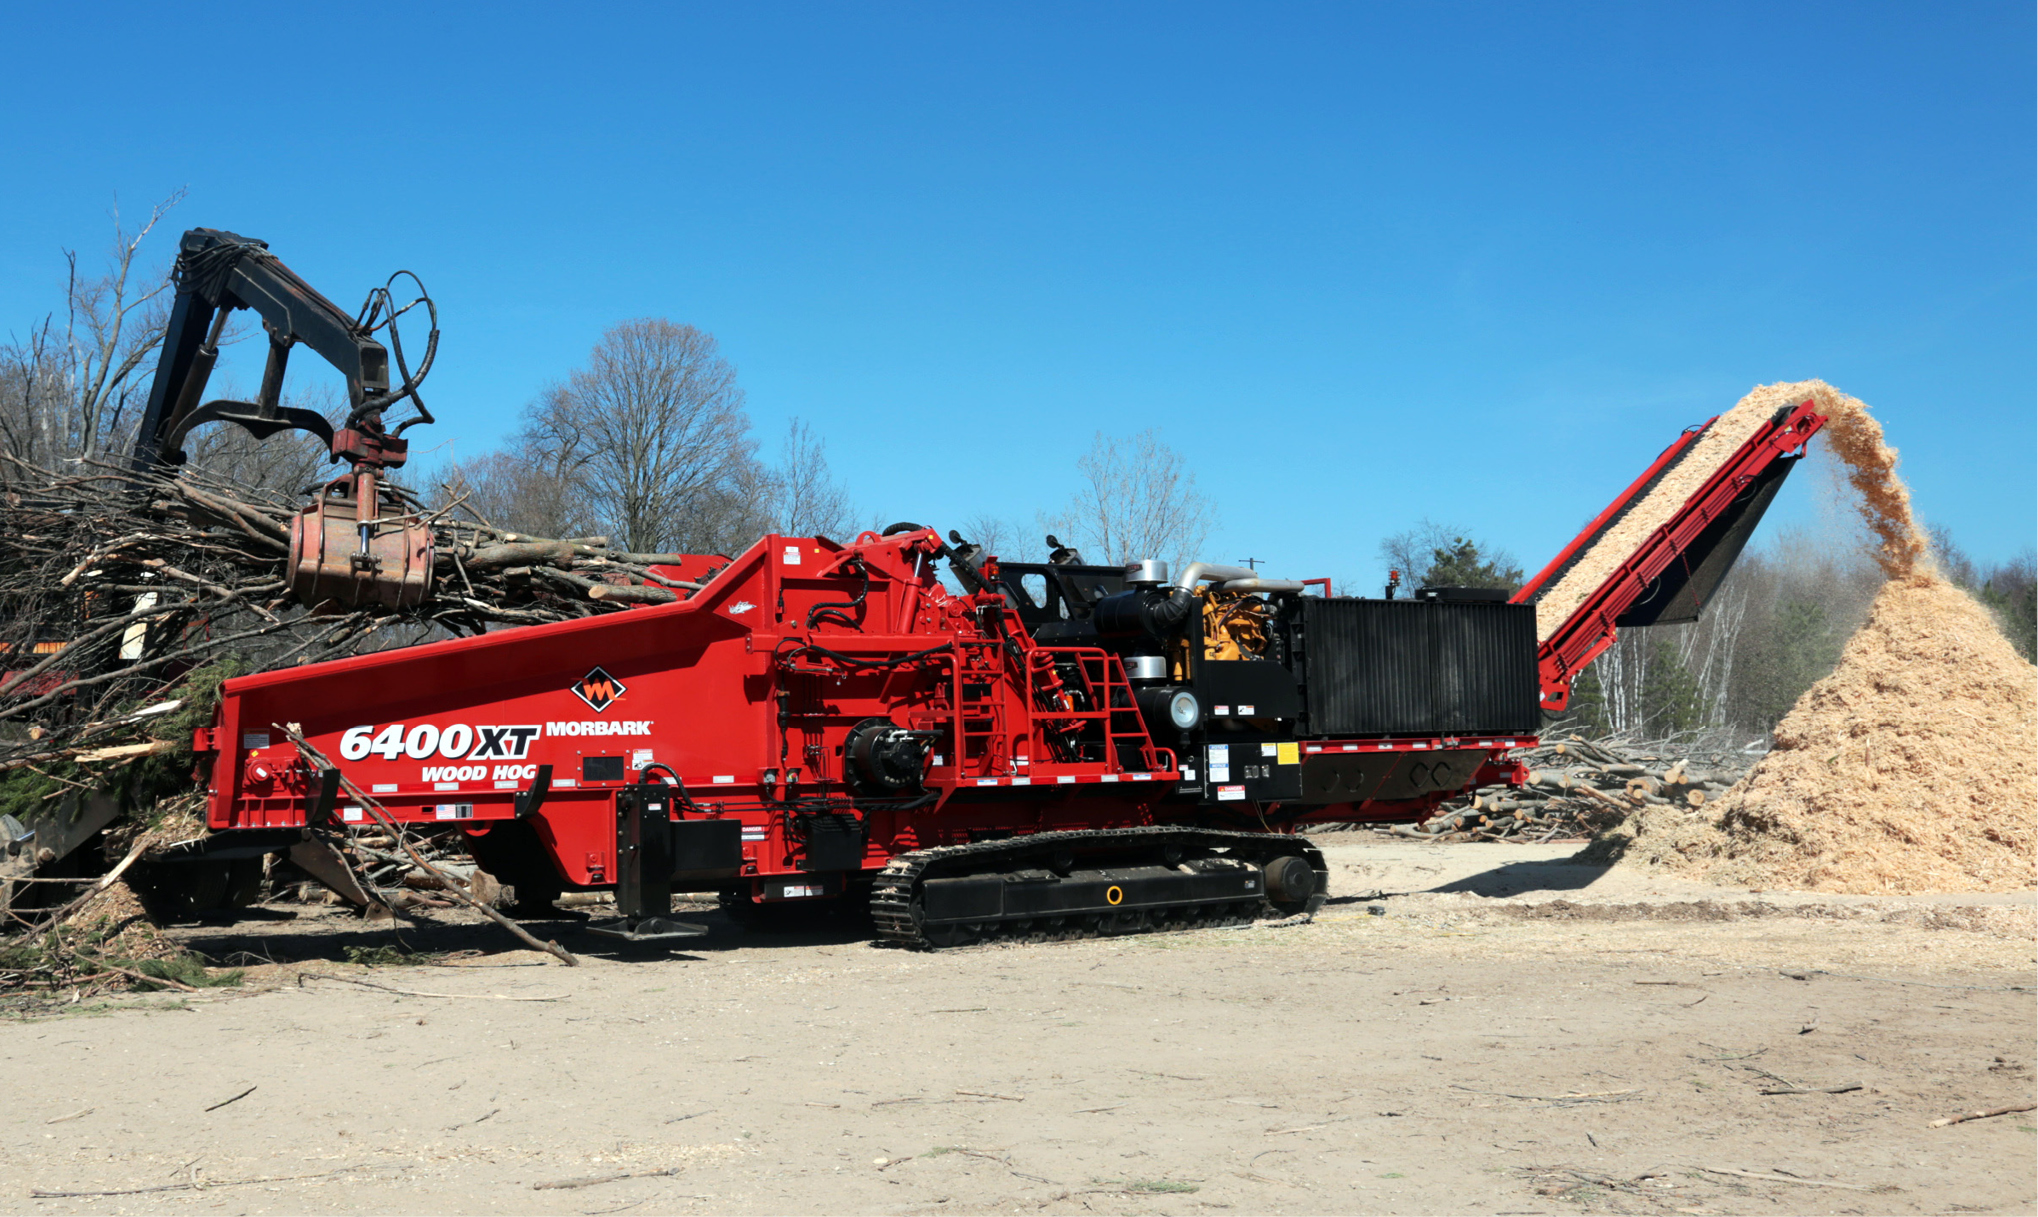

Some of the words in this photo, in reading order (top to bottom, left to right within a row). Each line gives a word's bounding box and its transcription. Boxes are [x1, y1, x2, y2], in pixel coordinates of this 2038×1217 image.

[546, 721, 651, 736] MORBARK
[422, 766, 487, 782] WOOD
[492, 764, 537, 780] HOG
